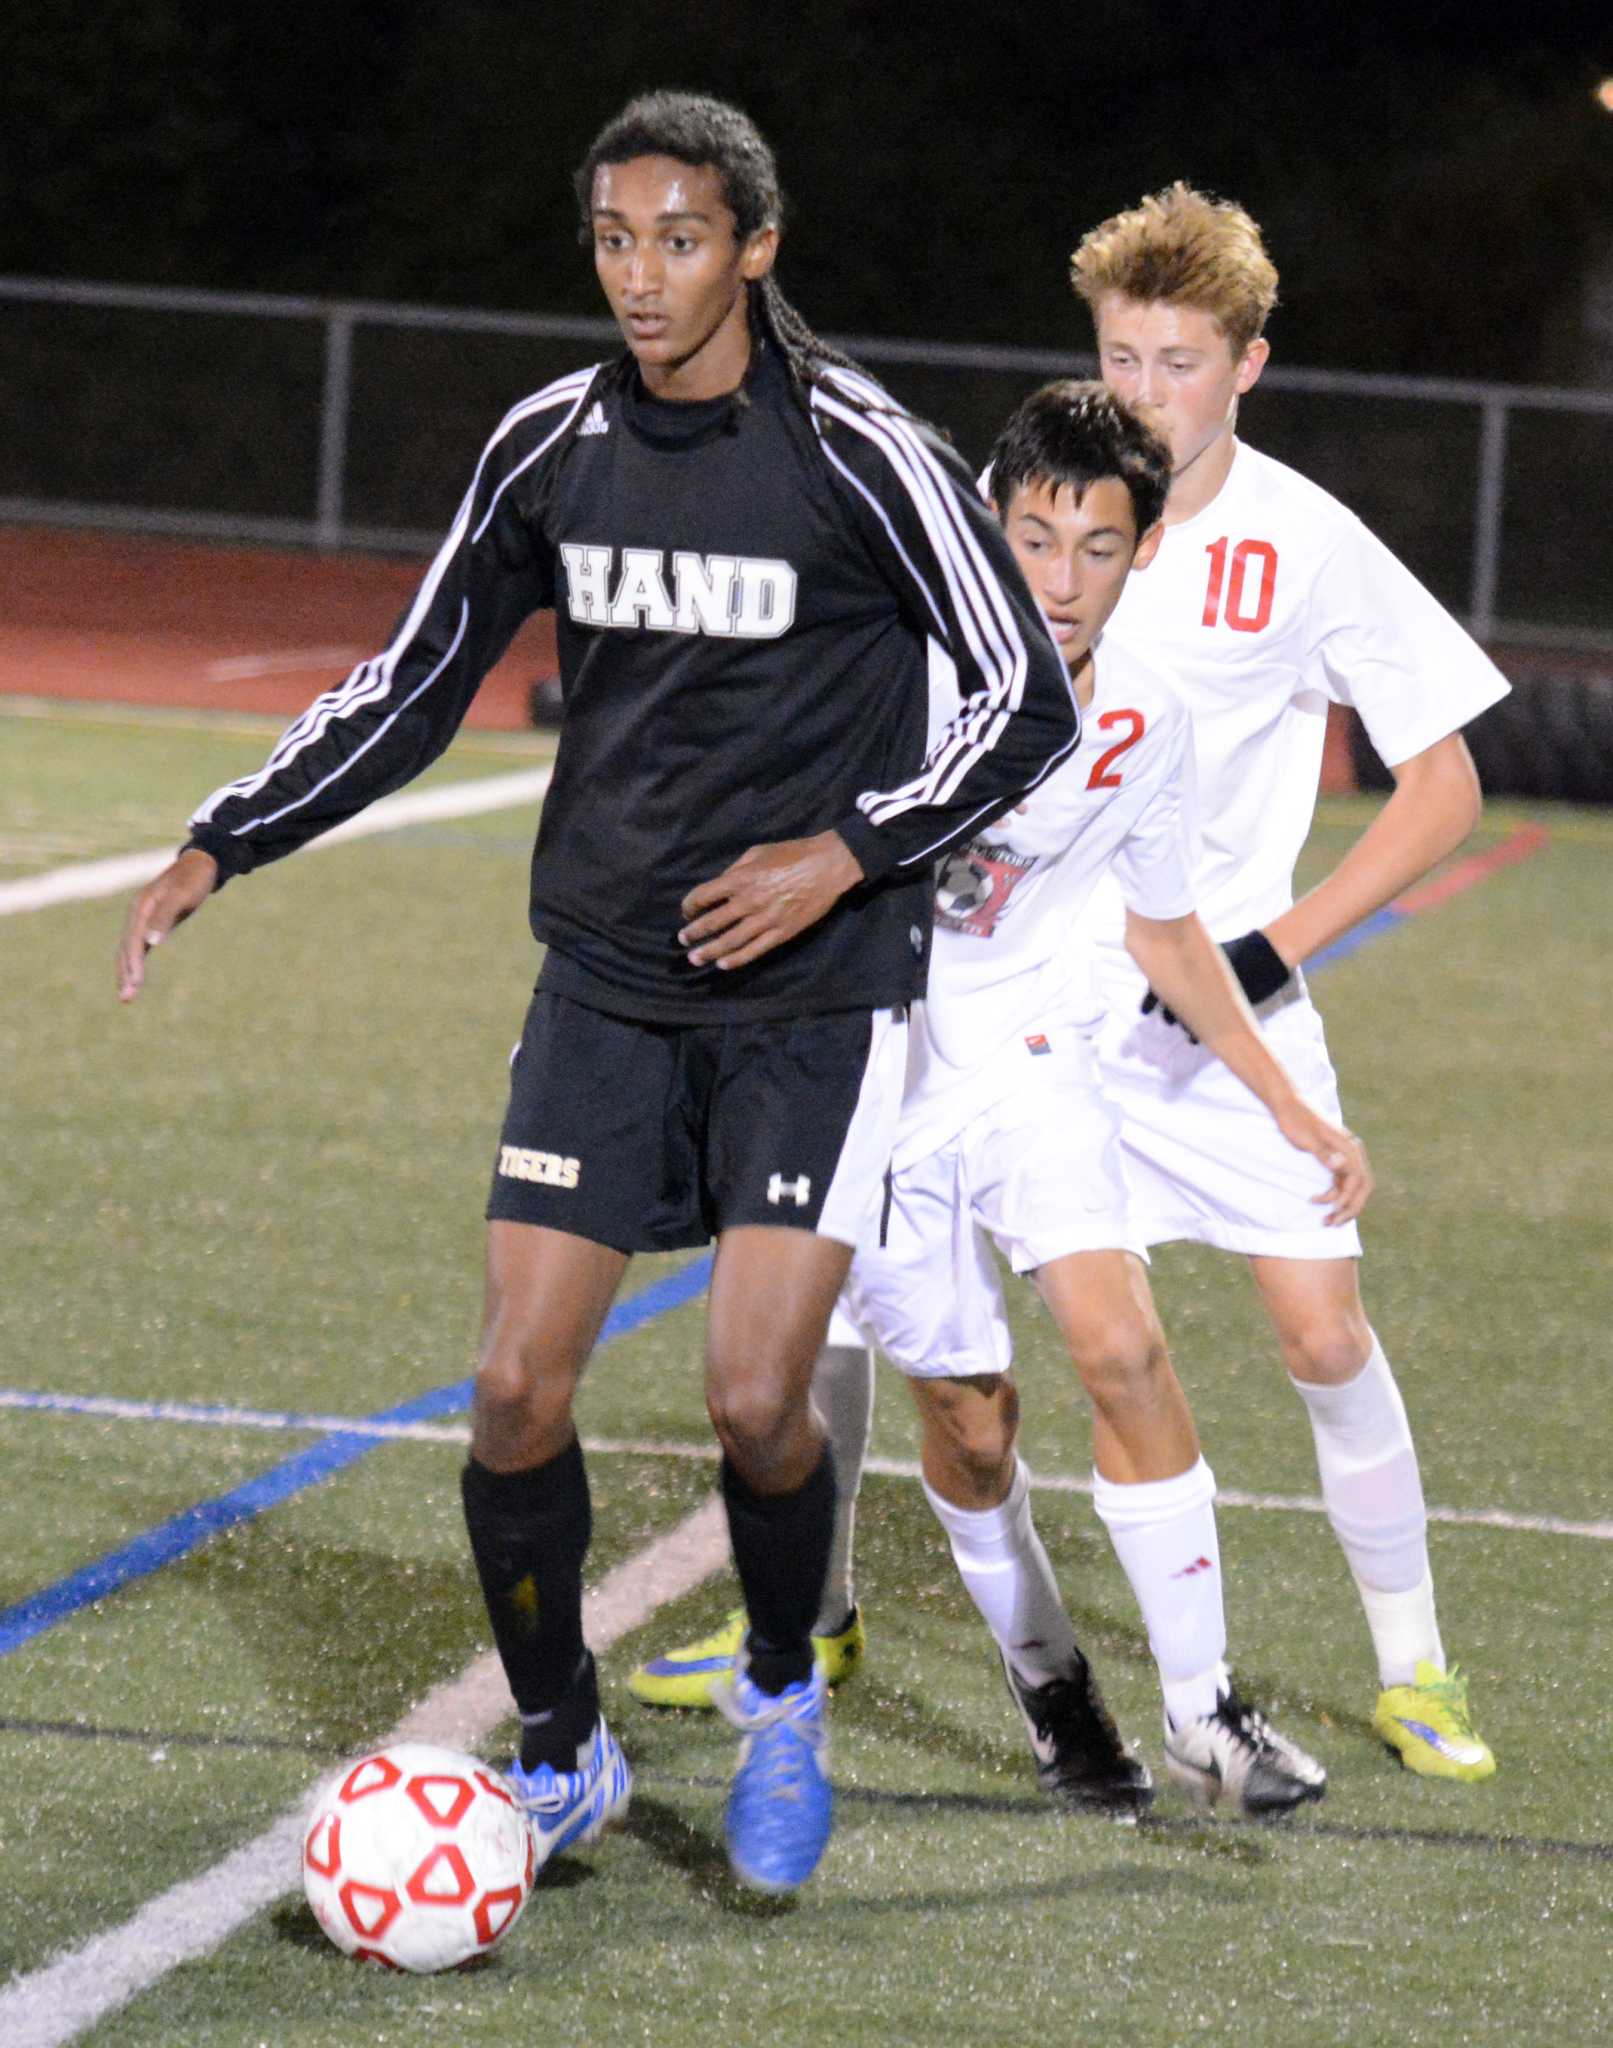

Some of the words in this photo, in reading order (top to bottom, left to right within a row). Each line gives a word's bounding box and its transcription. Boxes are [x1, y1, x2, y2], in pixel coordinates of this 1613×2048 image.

[559, 543, 798, 639] HAND
[1203, 537, 1278, 634] 10
[1087, 708, 1146, 790] 2
